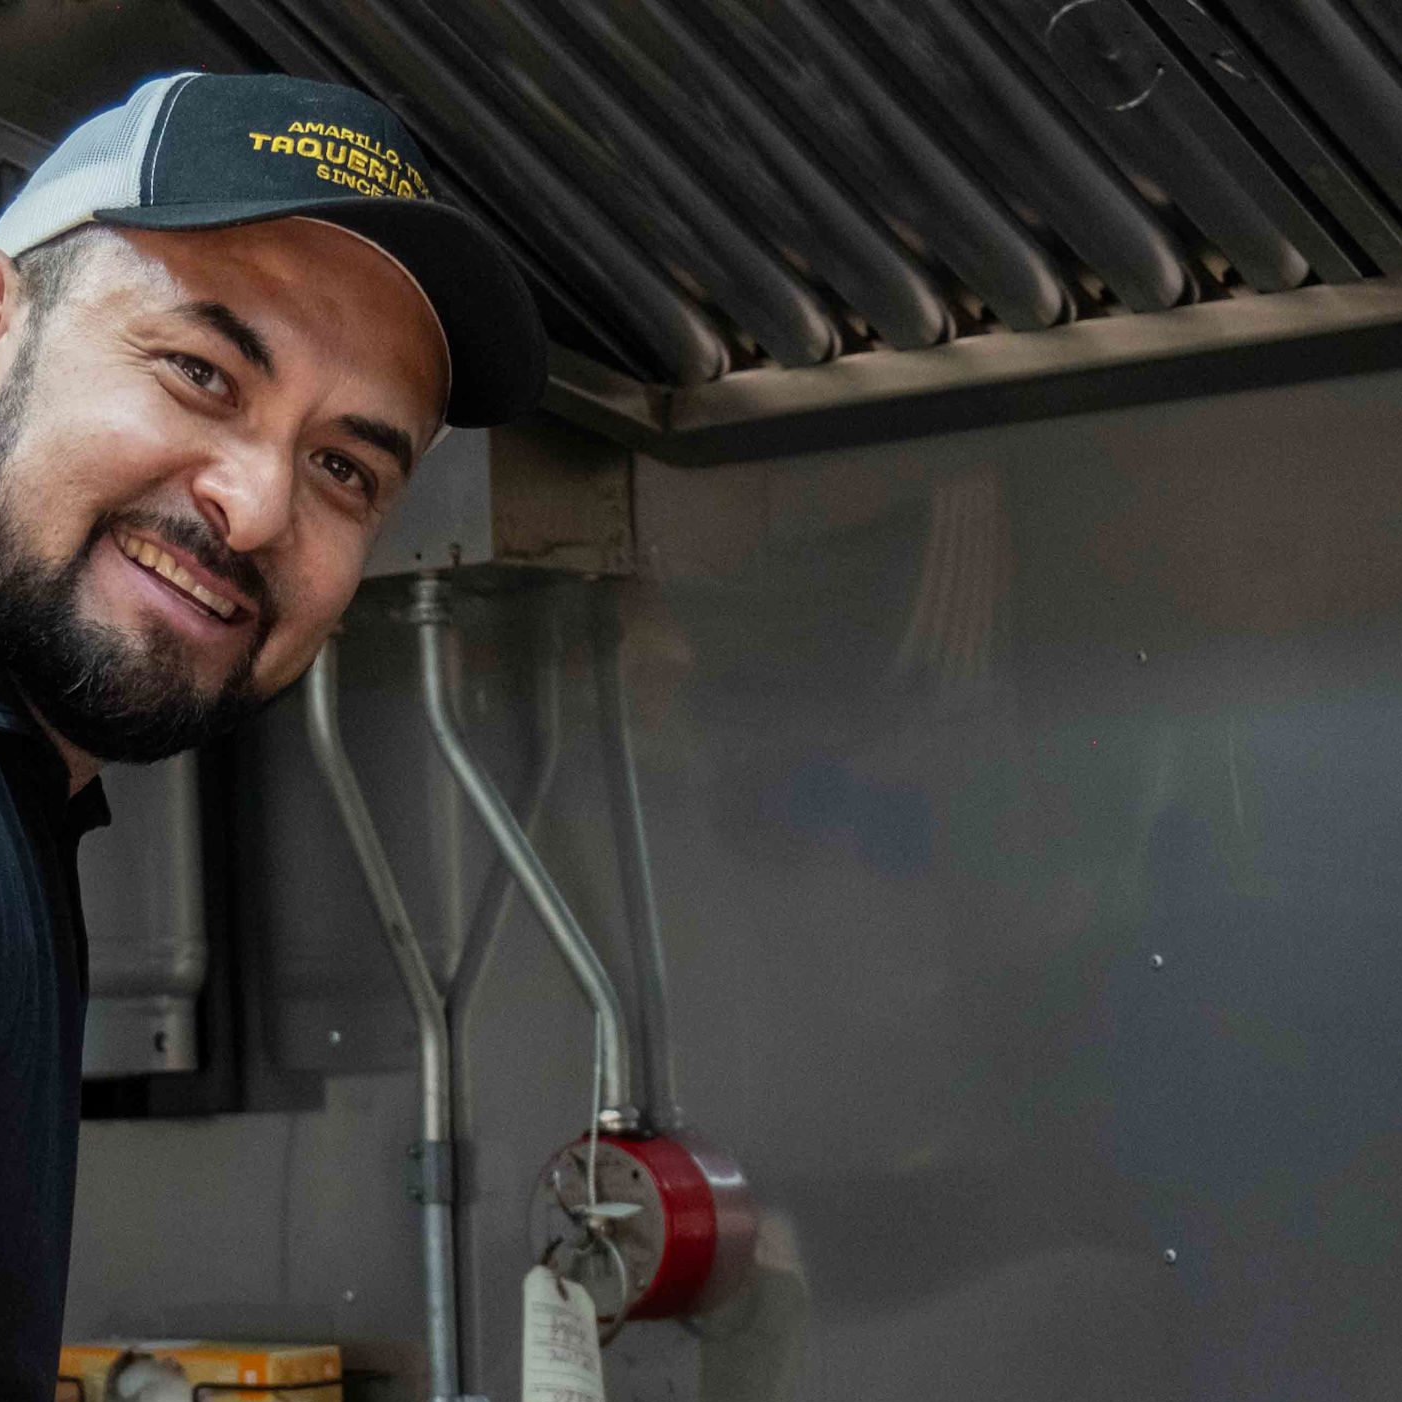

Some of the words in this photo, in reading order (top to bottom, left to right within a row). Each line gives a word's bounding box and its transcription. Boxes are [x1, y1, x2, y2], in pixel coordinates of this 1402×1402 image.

[249, 132, 417, 199] TAQUERIA
[288, 121, 402, 170] AMARILLO,
[316, 164, 385, 197] SINCE
